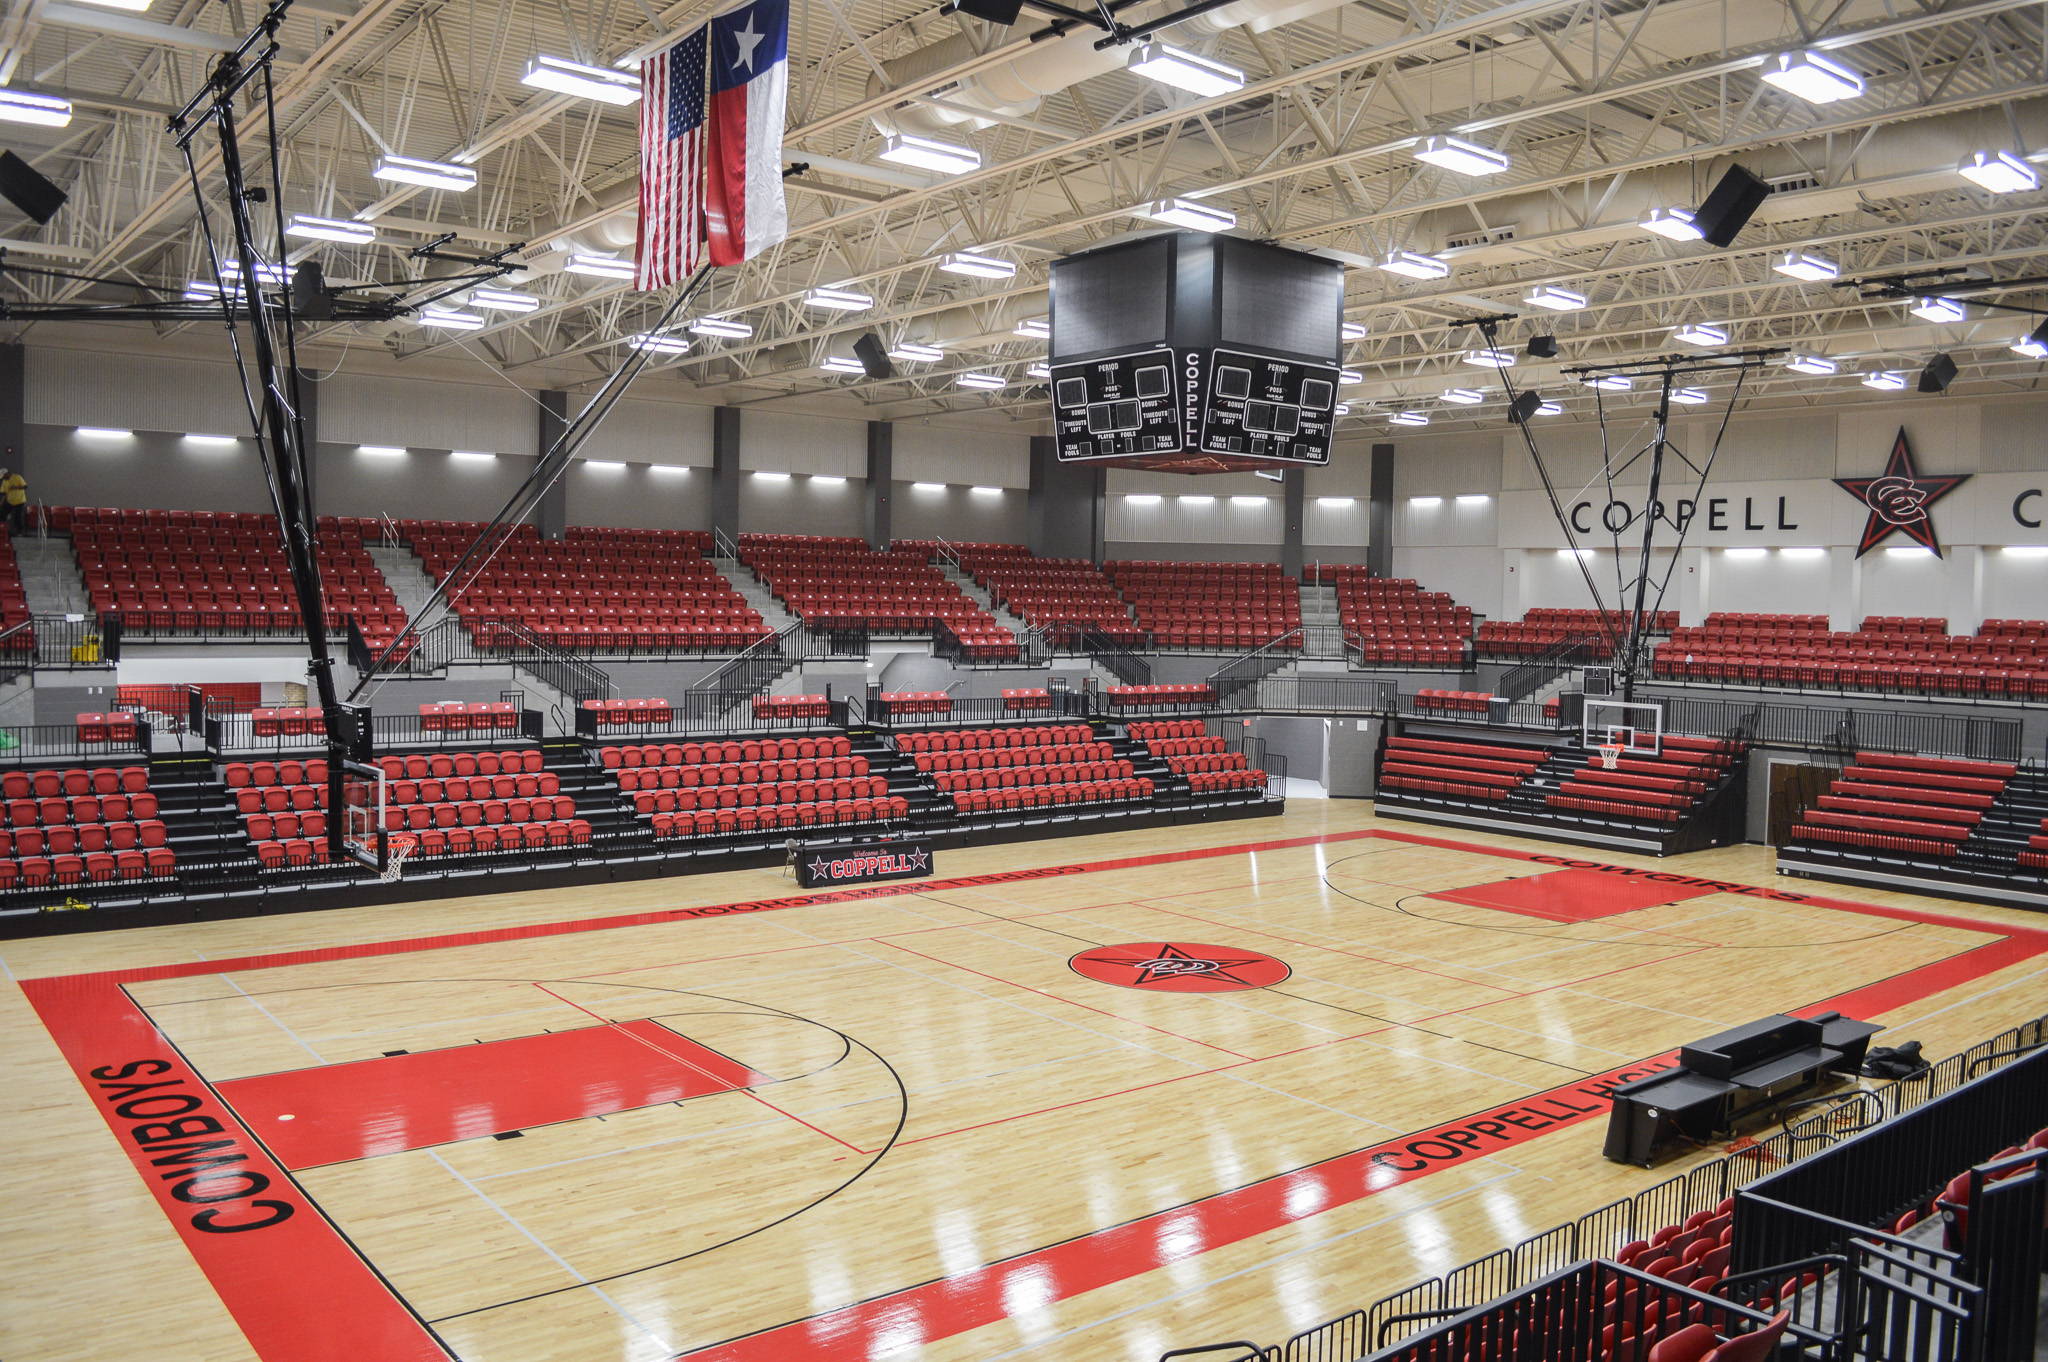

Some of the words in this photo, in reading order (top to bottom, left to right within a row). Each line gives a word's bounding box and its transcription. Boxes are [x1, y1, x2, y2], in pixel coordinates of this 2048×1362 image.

[1098, 363, 1119, 372] PERIOD
[1268, 364, 1289, 373] PERIOD
[1186, 353, 1199, 446] COPPELL
[1228, 401, 1245, 409] BONUS
[1143, 411, 1168, 419] TIMEOUTS
[1217, 411, 1243, 420] TIMEOUTS
[1301, 411, 1317, 419] BONUS
[1065, 420, 1087, 428] TIMEOUTS
[1300, 422, 1324, 430] TIMEOUTS
[1212, 435, 1226, 443] TEAM
[1250, 432, 1269, 440] PLAYER
[1210, 441, 1227, 449] FOULS
[1571, 496, 1798, 534] COPPELL
[831, 854, 911, 879] COPPELL
[933, 866, 1085, 886] COPPELL
[1529, 855, 1810, 902] COWGIRLS
[669, 895, 839, 917] SCHOOL
[1371, 1099, 1604, 1172] COPPELL
[90, 1060, 295, 1233] COWBOYS
